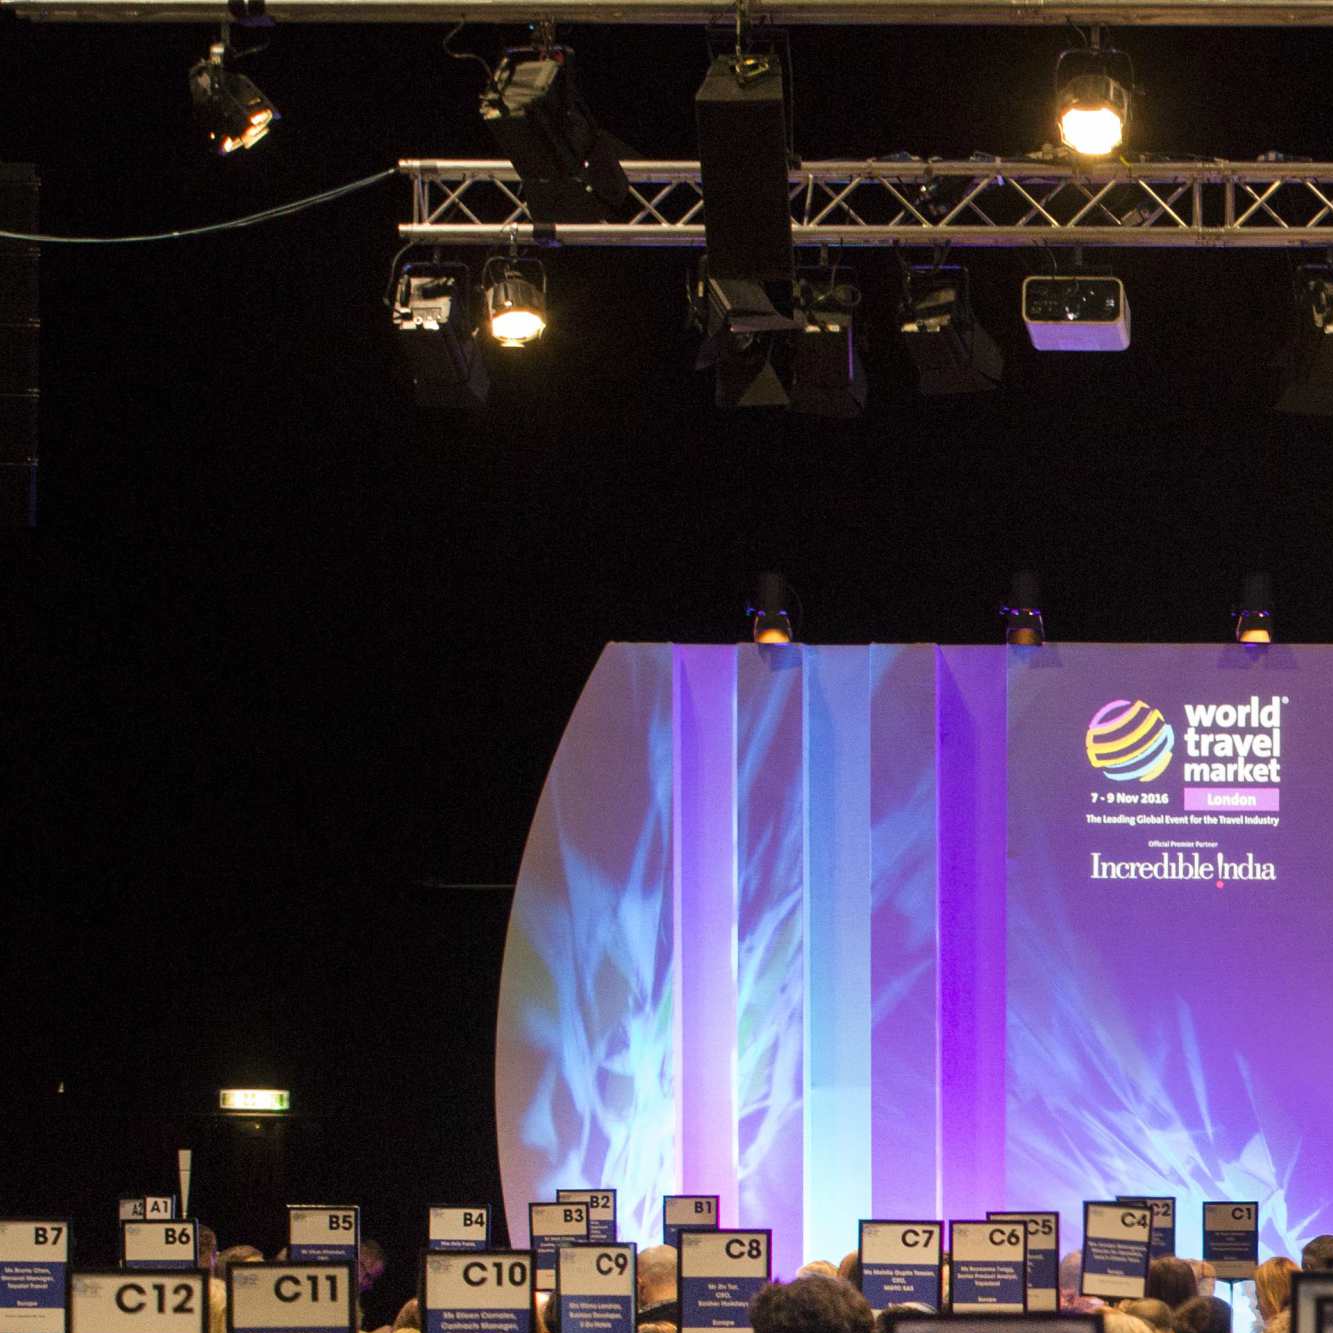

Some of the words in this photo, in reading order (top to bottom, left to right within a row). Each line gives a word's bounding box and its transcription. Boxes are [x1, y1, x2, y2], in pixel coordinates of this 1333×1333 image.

[1184, 696, 1281, 727] world
[1184, 728, 1281, 757] travel
[1184, 757, 1281, 782] market
[1091, 793, 1099, 804] 7
[1107, 793, 1115, 804] 9
[1117, 793, 1140, 804] Nov
[1141, 793, 1169, 804] 2016
[1207, 793, 1257, 806] London
[1086, 814, 1101, 824] The
[1103, 815, 1135, 826] Leading
[1137, 815, 1164, 825] Global
[1165, 815, 1188, 825] Event
[1190, 815, 1202, 825] for
[1203, 815, 1218, 825] the
[1219, 816, 1243, 825] Travel
[1245, 816, 1279, 827] Industry
[1148, 840, 1170, 848] Official
[1090, 852, 1214, 880] Incredible
[150, 1201, 168, 1213] A1
[590, 1195, 610, 1209] B2
[694, 1201, 712, 1214] B1
[1152, 1203, 1171, 1217] C2
[463, 1212, 485, 1227] B4
[563, 1209, 584, 1222] B3
[1121, 1212, 1148, 1229] C4
[1232, 1207, 1251, 1220] C1
[329, 1215, 353, 1231] B5
[1027, 1219, 1053, 1236] C5
[34, 1227, 63, 1245] B7
[165, 1228, 191, 1245] B6
[901, 1229, 934, 1248] C7
[989, 1229, 1020, 1246] C6
[725, 1238, 762, 1260] C8
[596, 1253, 628, 1275] C9
[463, 1261, 527, 1287] C10
[274, 1275, 338, 1302] C11
[115, 1283, 195, 1314] C12
